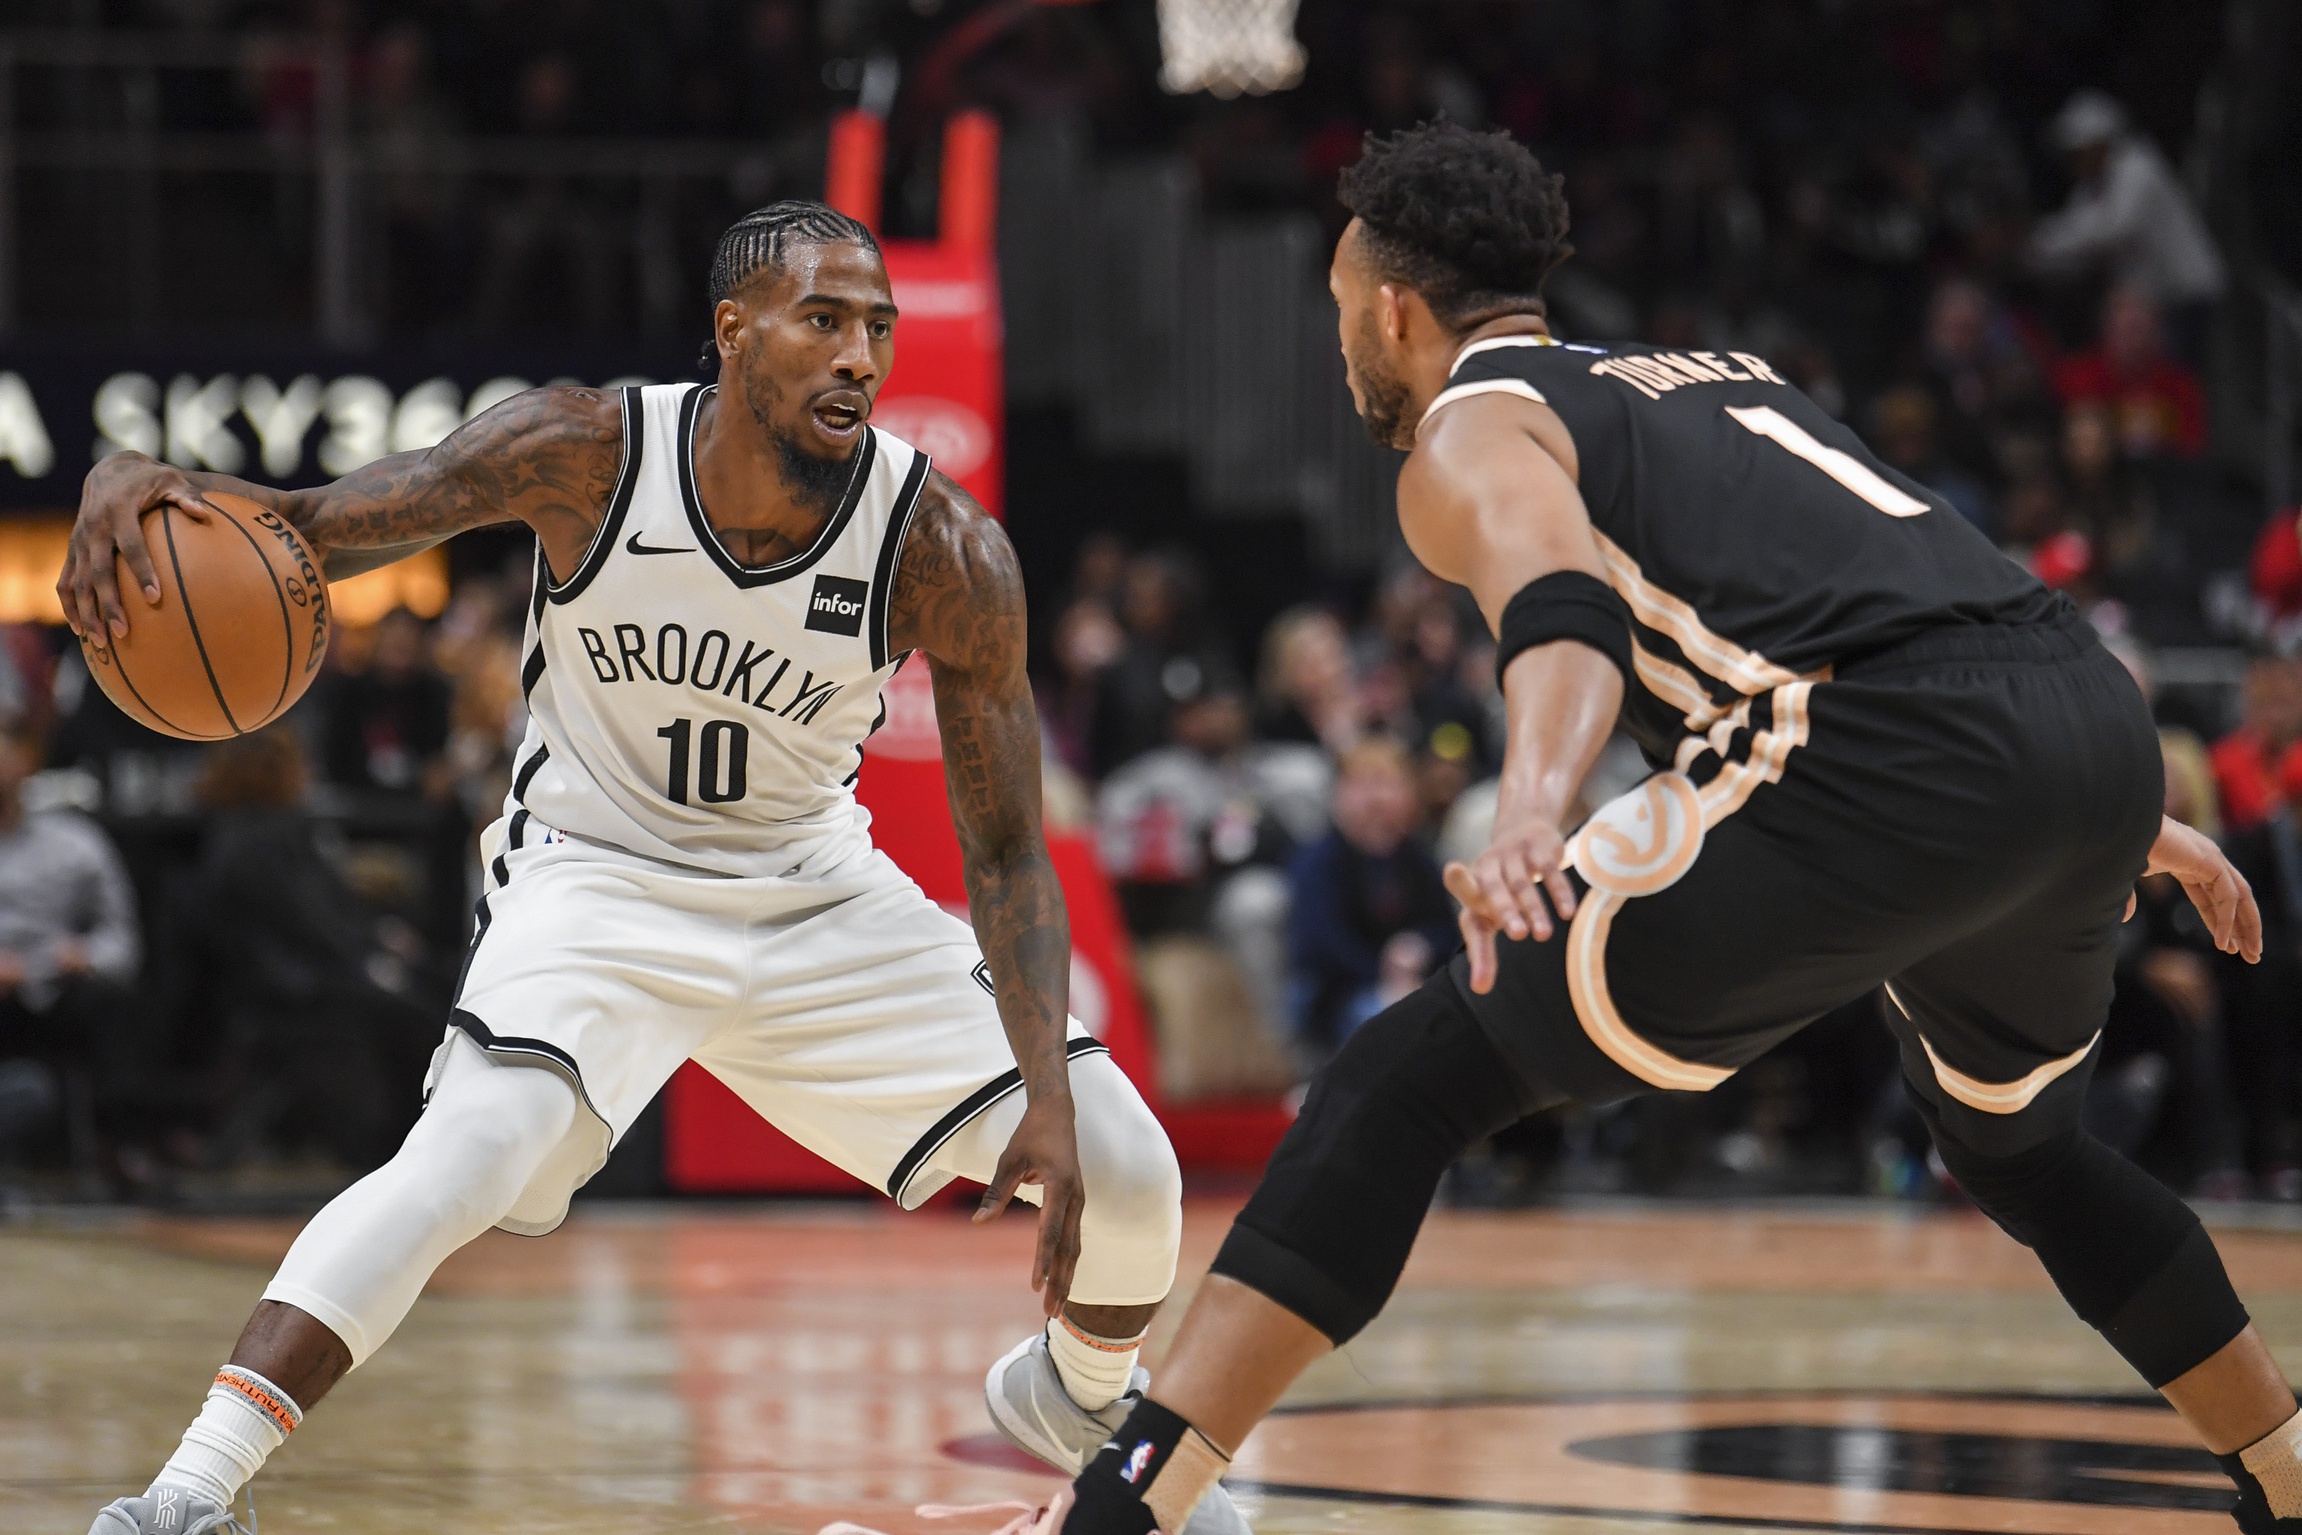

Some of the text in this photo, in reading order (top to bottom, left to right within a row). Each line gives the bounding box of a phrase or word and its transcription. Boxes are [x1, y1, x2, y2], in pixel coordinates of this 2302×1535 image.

[1589, 351, 1787, 400] TURNER
[1724, 405, 1932, 518] 1
[813, 591, 863, 617] infor
[577, 623, 846, 726] BROOKLYN
[657, 718, 750, 806] 10
